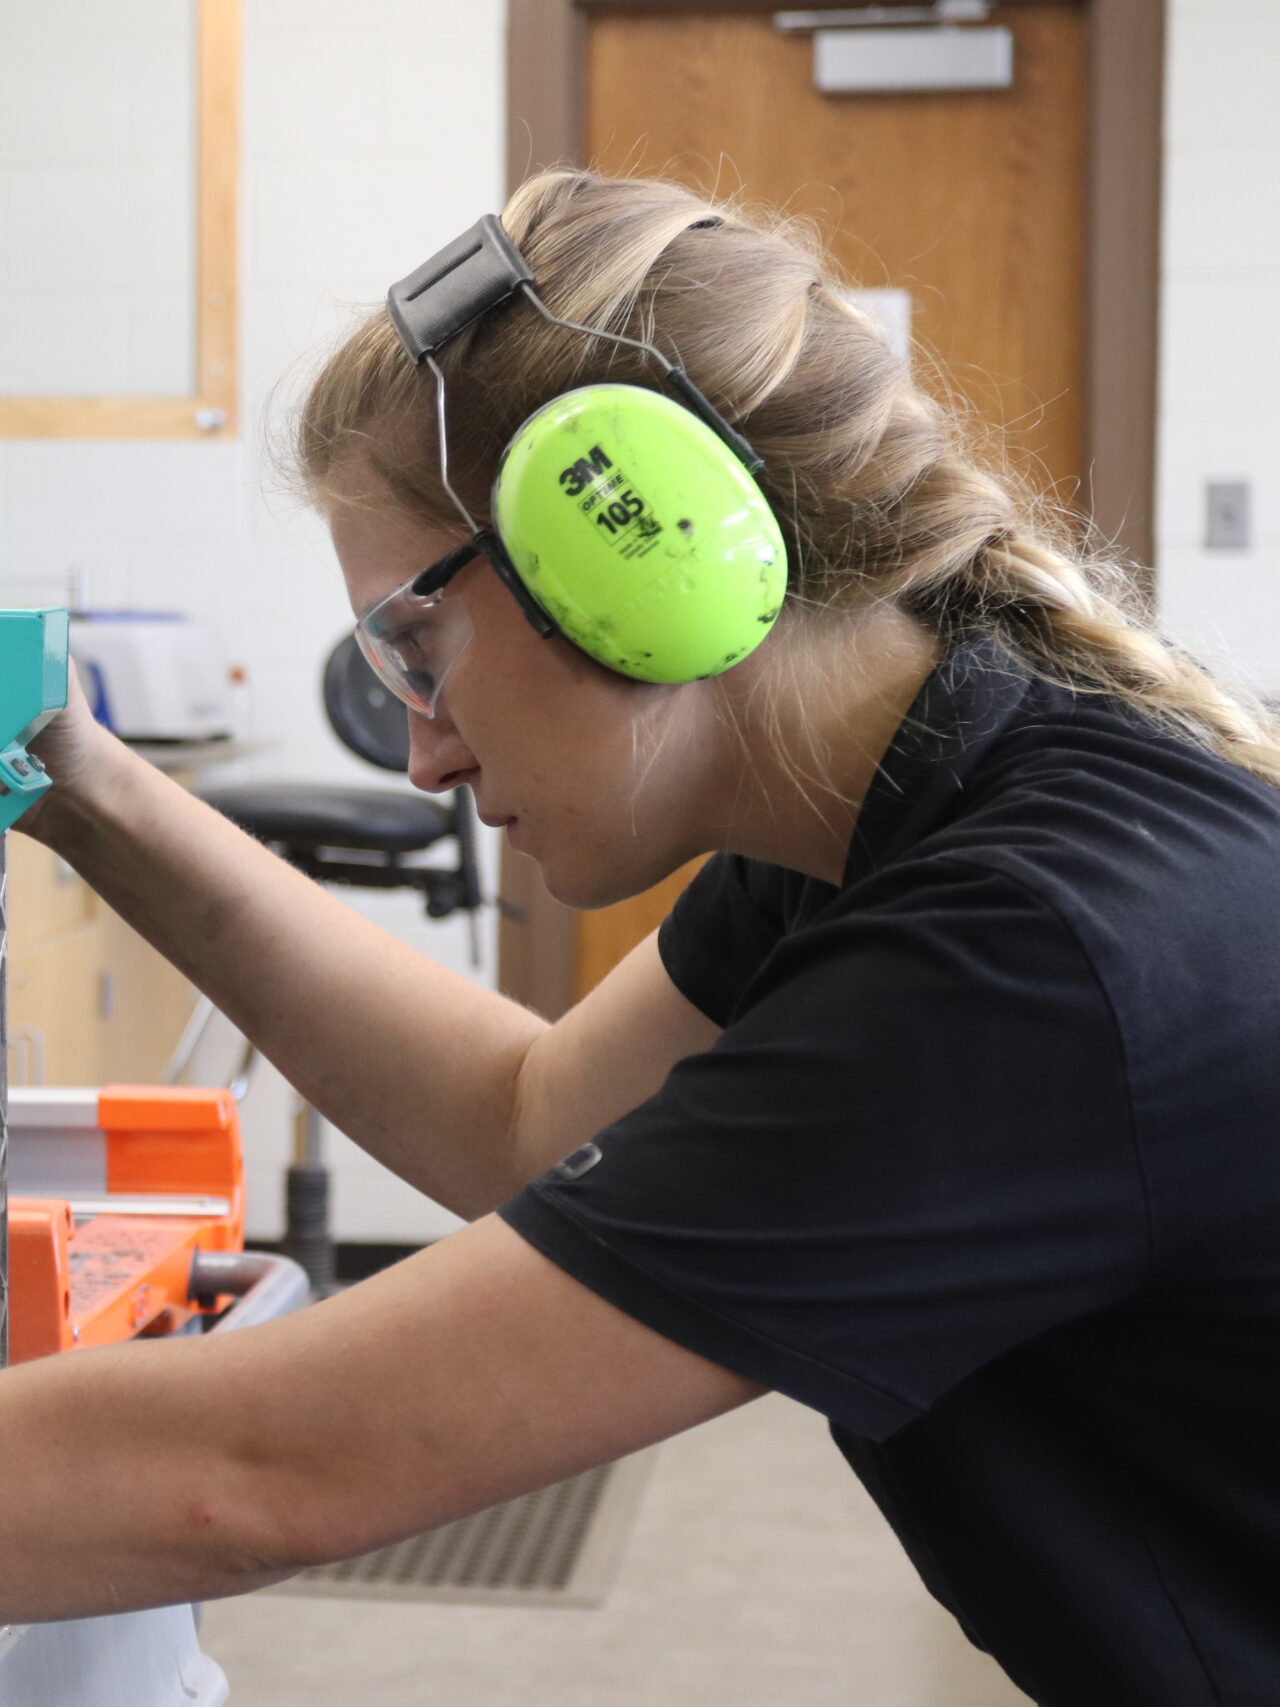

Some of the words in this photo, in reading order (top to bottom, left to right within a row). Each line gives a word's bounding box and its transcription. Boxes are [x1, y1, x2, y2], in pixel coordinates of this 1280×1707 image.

[558, 444, 614, 497] 3M
[582, 473, 625, 512] OPTIME
[596, 489, 645, 535] 105
